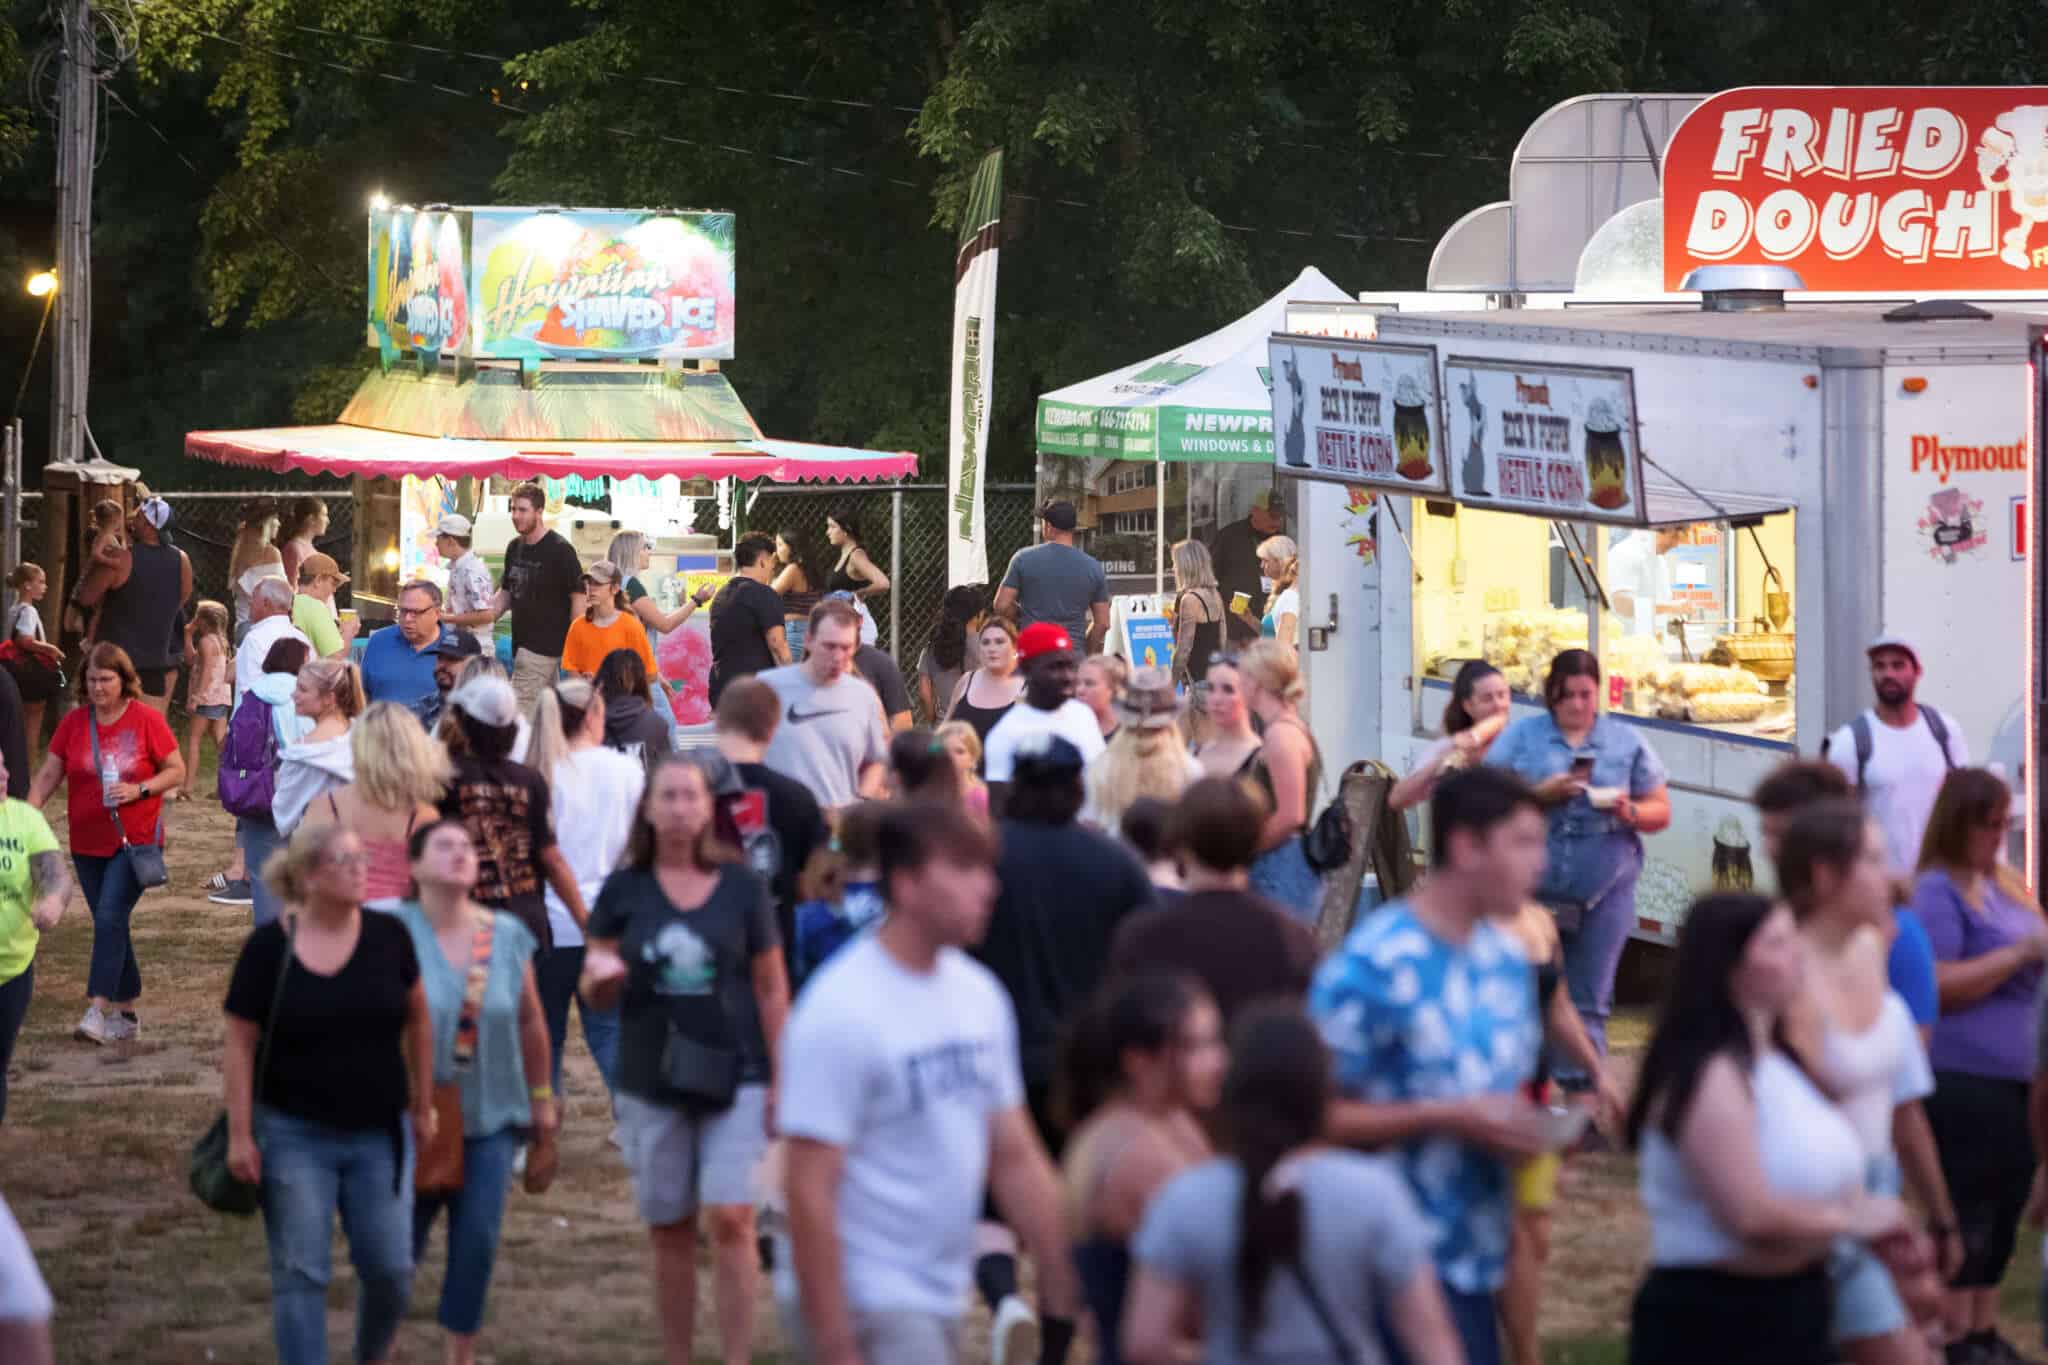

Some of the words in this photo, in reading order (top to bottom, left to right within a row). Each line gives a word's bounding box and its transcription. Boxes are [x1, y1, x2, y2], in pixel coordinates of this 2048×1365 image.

[1712, 106, 1968, 181] FRIED
[1686, 189, 1999, 264] DOUGH
[487, 252, 673, 334] Hawaiian
[560, 296, 666, 335] SHAVED
[671, 296, 717, 329] ICE
[1181, 438, 1249, 453] WINDOWS
[1253, 439, 1264, 453] &
[1316, 430, 1358, 469] KETTLE
[1359, 434, 1393, 474] CORN
[1911, 434, 2027, 484] Plymout
